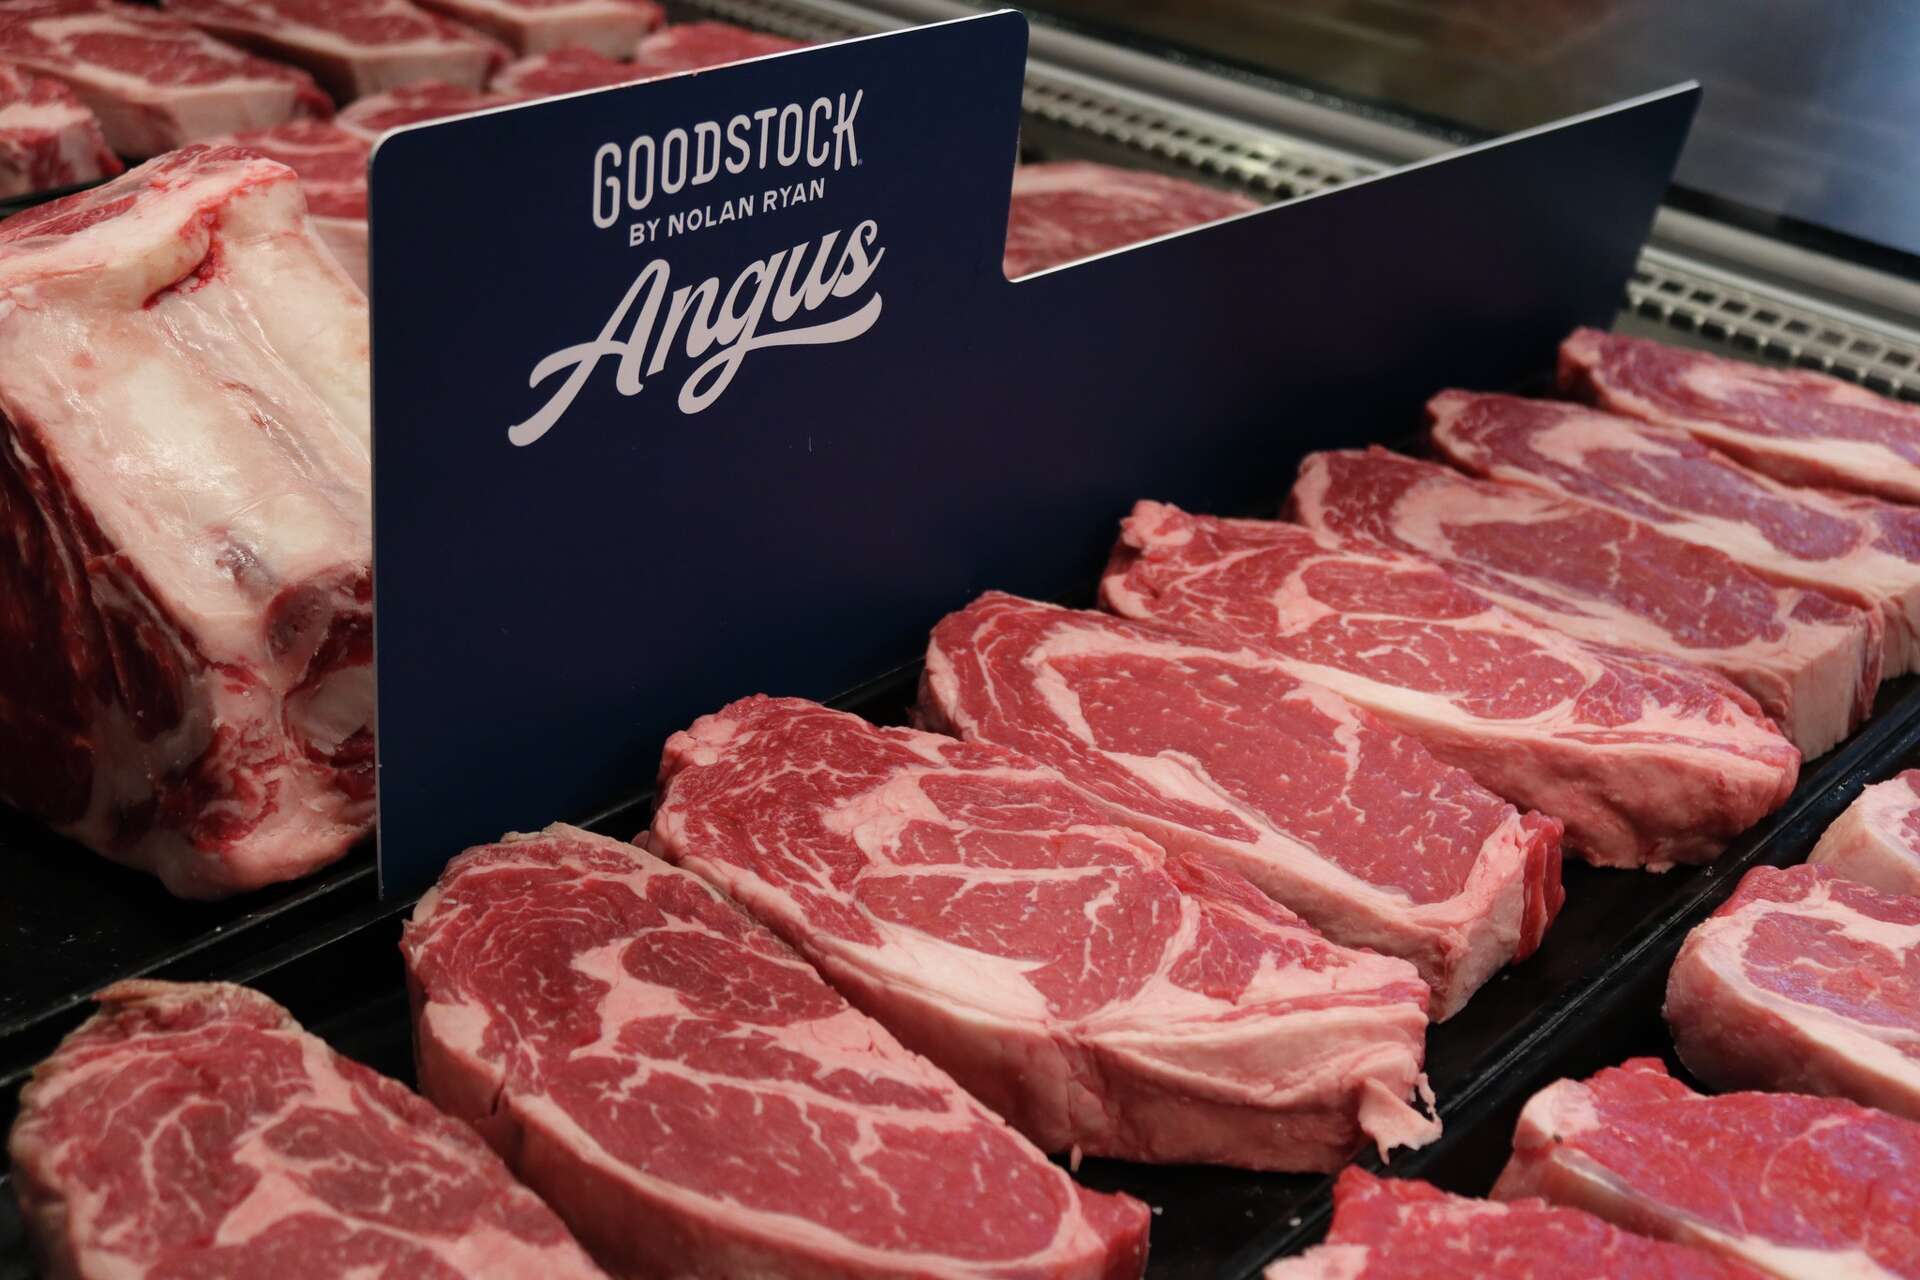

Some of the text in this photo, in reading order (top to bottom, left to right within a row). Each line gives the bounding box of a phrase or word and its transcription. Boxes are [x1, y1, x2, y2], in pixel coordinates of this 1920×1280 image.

[592, 88, 864, 229] GOODSTOCK
[629, 178, 825, 247] BY NOLAN RYAN
[508, 220, 886, 447] Angus
